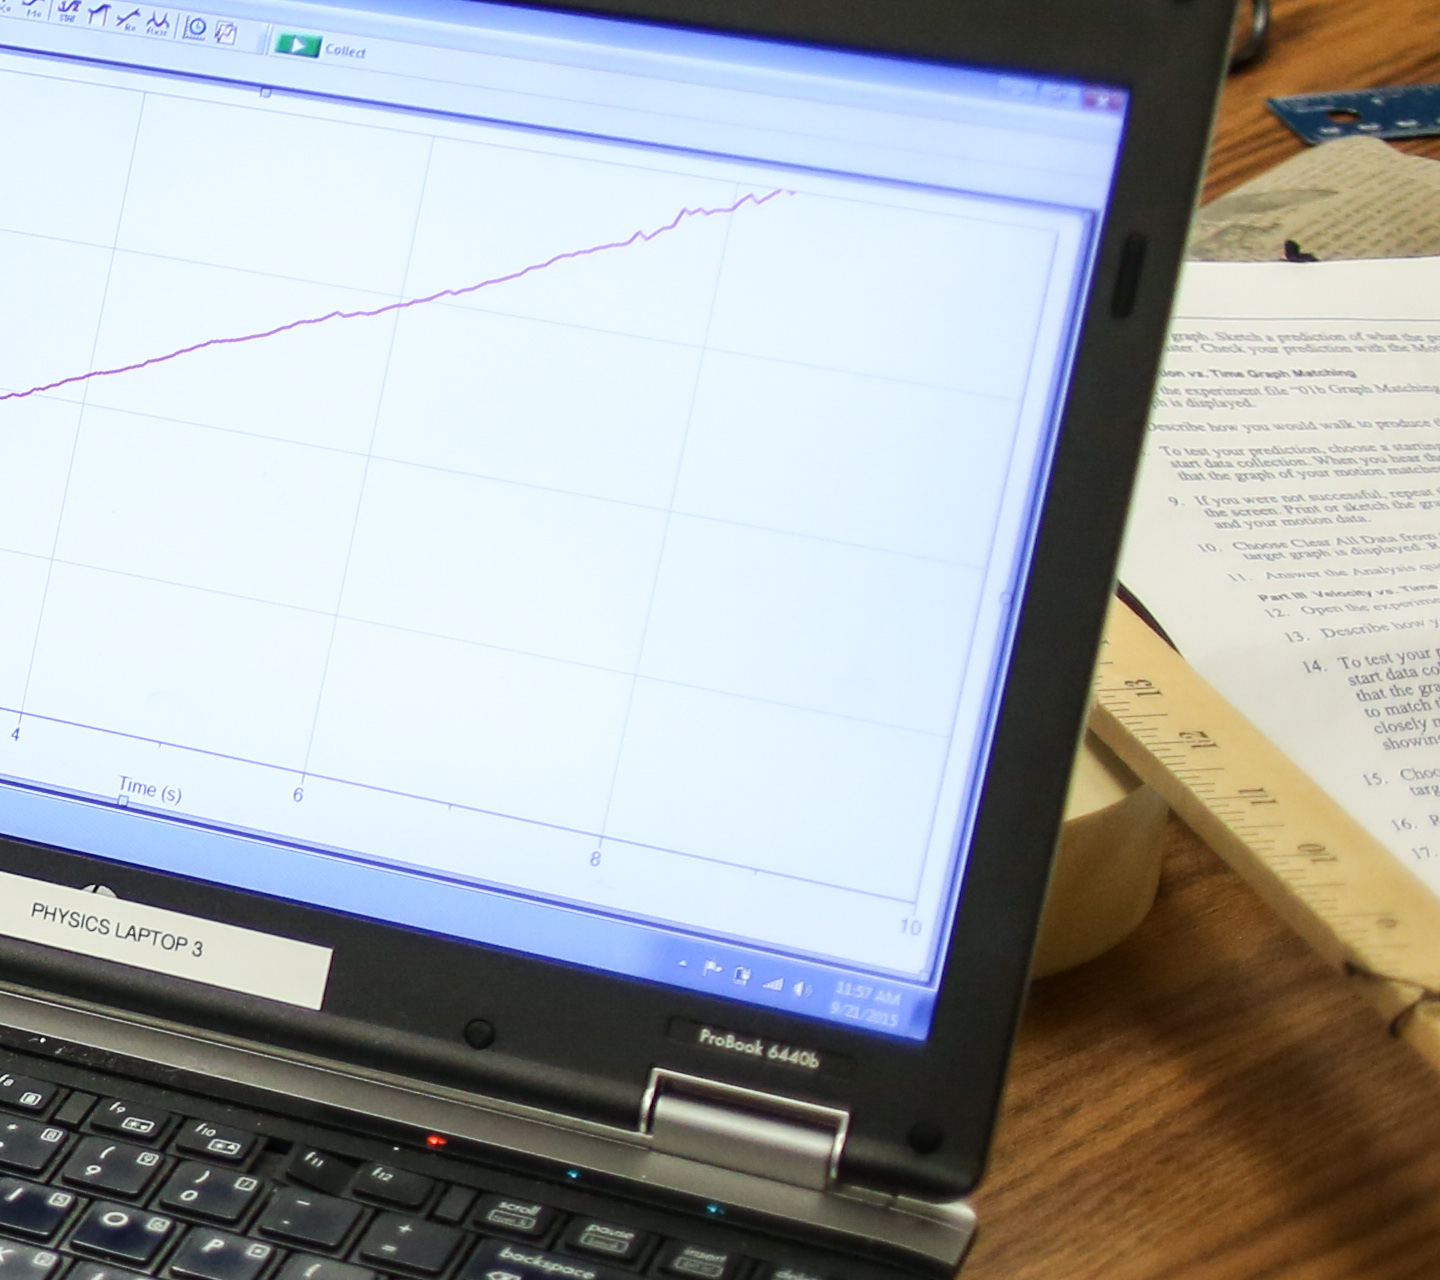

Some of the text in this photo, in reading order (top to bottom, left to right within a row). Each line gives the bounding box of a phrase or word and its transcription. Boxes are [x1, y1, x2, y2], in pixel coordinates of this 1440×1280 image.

[325, 43, 367, 60] Collect
[1232, 540, 1288, 551] Choose
[1291, 538, 1330, 549] Clear
[1361, 534, 1397, 545] Data
[1290, 549, 1331, 560] graph
[1353, 563, 1416, 576] Analysis
[1258, 592, 1291, 602] Part
[1313, 587, 1371, 599] Velocity
[1265, 603, 1369, 619] 12. Open the
[1285, 618, 1424, 643] 13. Describe how
[1303, 648, 1430, 673] 14. To test your
[1348, 667, 1419, 686] start data
[1356, 684, 1414, 702] that the
[1364, 698, 1432, 718] to match
[10, 726, 21, 743] 4
[1374, 717, 1427, 735] closely
[1363, 772, 1389, 786] 15.
[119, 775, 182, 805] Time (s)
[292, 787, 303, 803] 6
[1391, 818, 1418, 831] 16.
[589, 849, 601, 868] 8
[1411, 846, 1438, 859] 17.
[31, 902, 203, 958] PHYSICS LAPTOP 3
[901, 918, 922, 936] 10
[836, 980, 901, 1006] 11:57 AM
[699, 1028, 820, 1070] ProBook 6440b
[194, 1122, 217, 1137] f10
[85, 1163, 102, 1176] 9
[6, 1187, 23, 1201] I
[102, 1211, 128, 1227] O
[585, 1223, 635, 1242] pause
[202, 1238, 224, 1253] P
[500, 1247, 596, 1280] backspace
